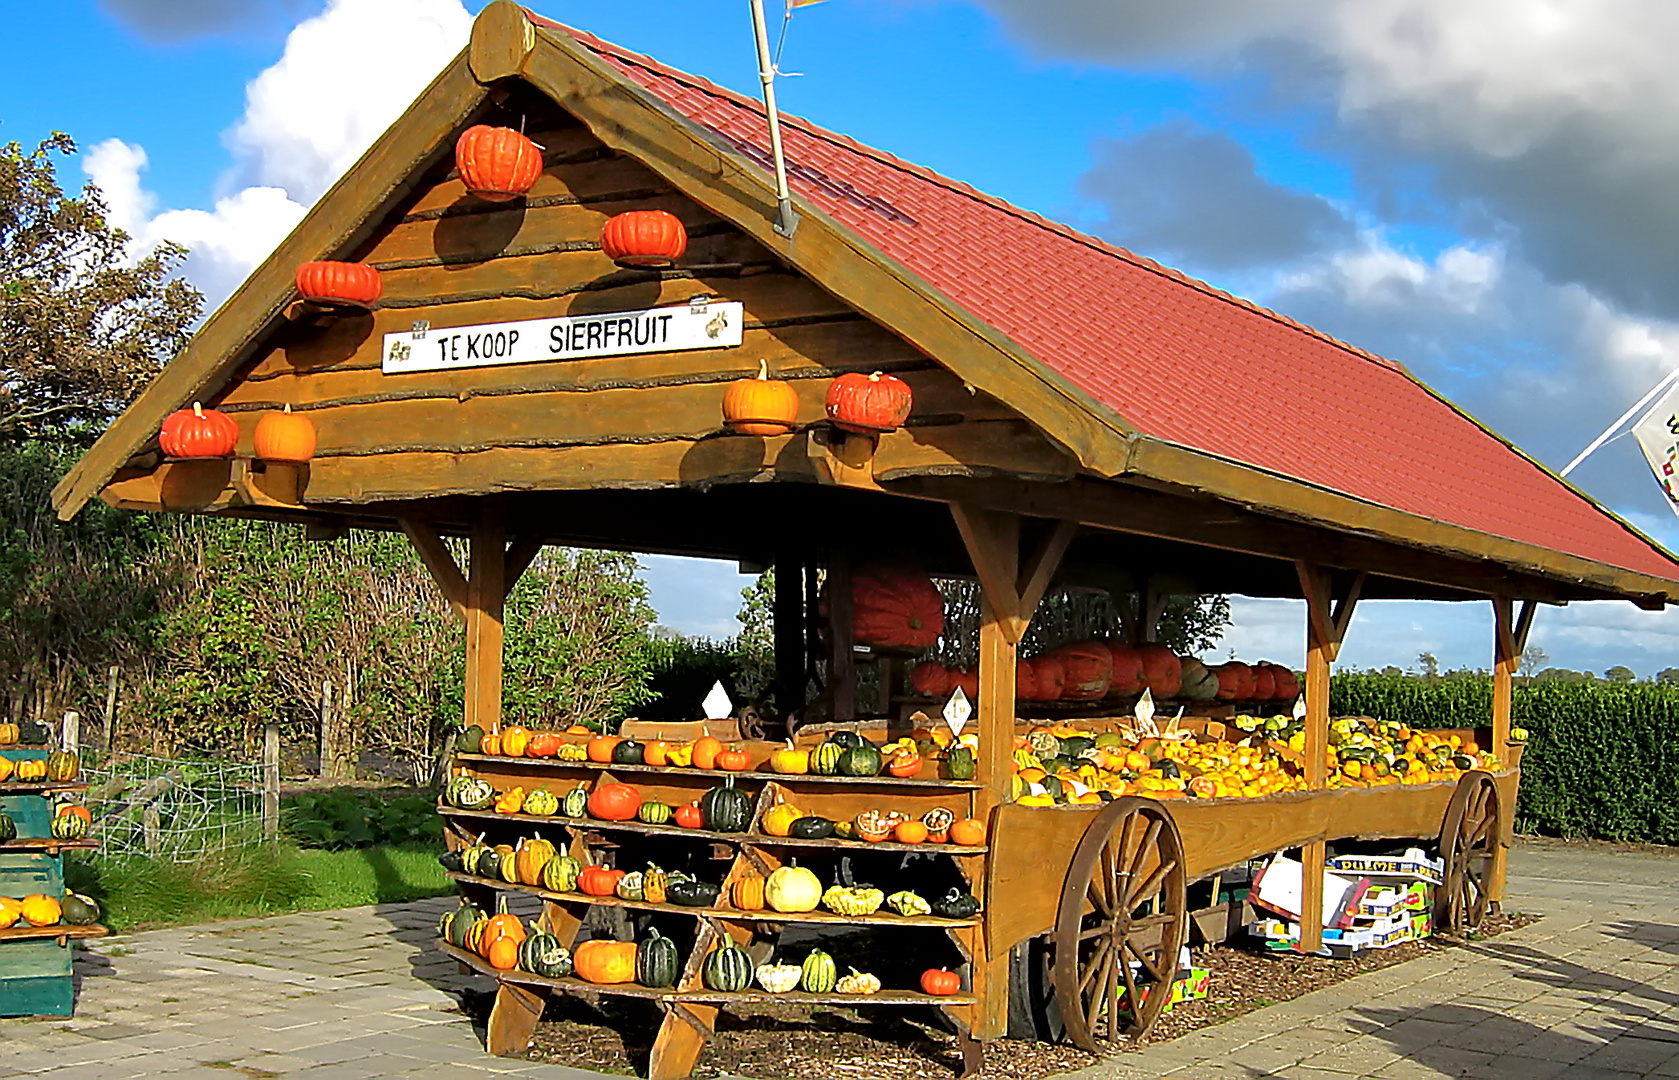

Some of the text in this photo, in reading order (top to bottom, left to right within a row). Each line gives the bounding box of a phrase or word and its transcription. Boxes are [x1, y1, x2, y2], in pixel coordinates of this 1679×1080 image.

[438, 315, 673, 361] TE KOOP SIERFRUIT
